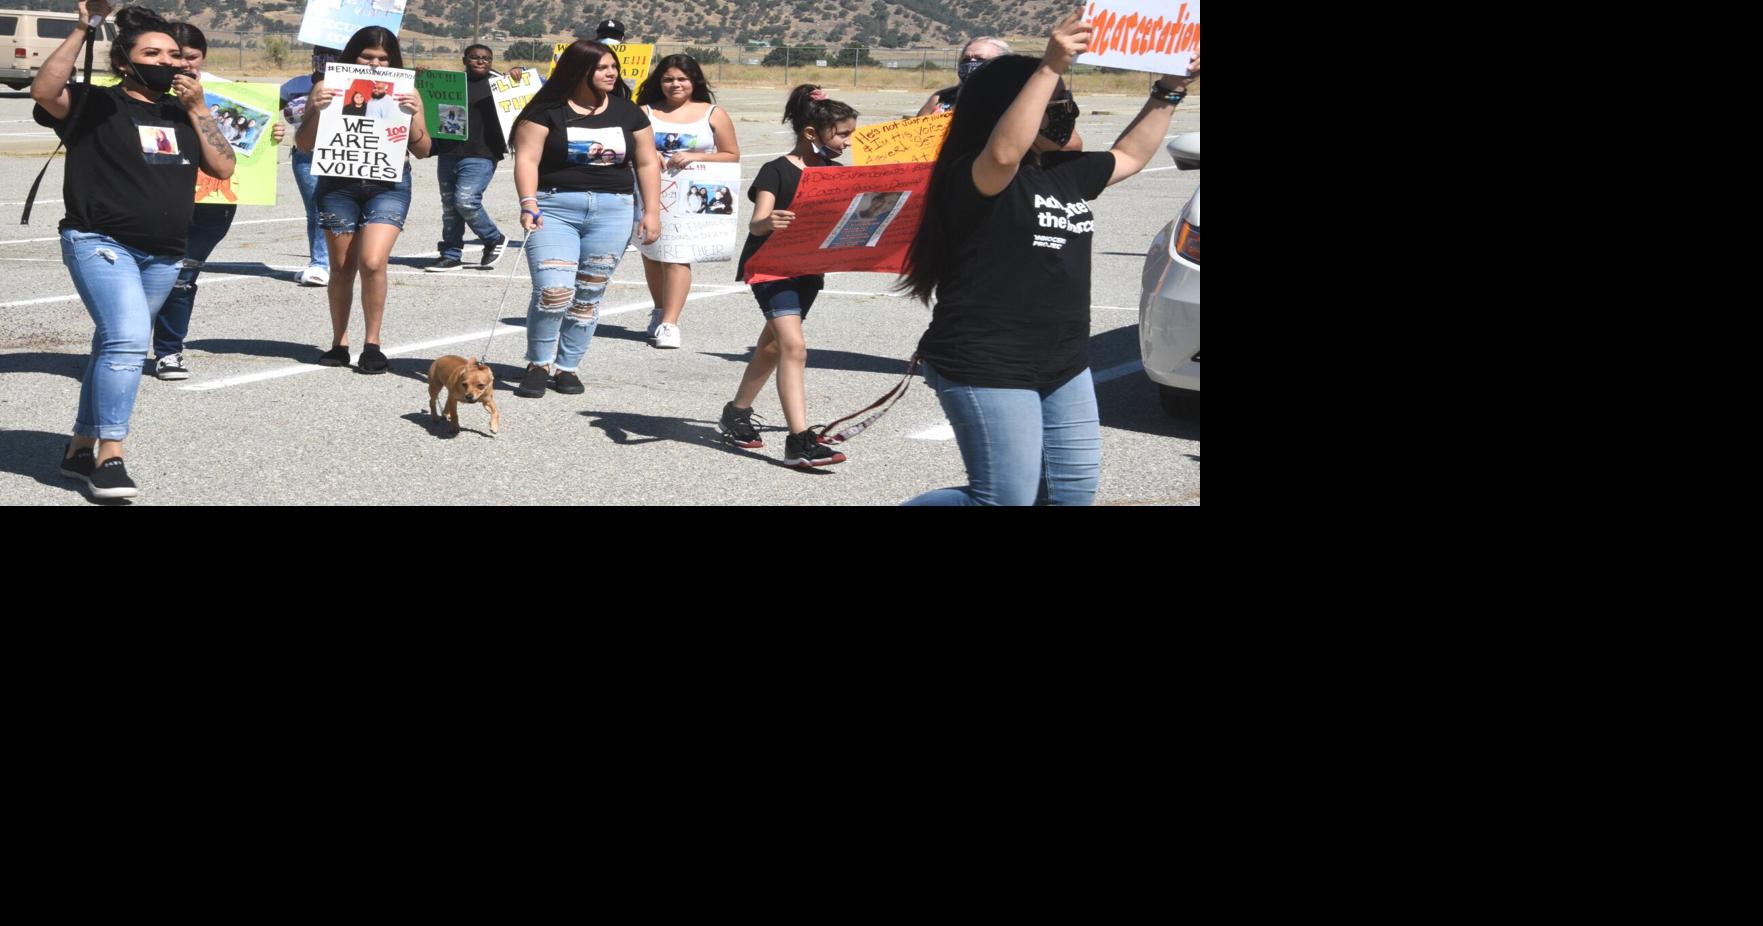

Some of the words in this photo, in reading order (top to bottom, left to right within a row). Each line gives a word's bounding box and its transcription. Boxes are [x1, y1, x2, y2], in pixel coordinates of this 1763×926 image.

[428, 89, 465, 101] VOICE
[343, 118, 374, 134] WE
[329, 133, 379, 150] ARE
[317, 148, 392, 167] THEIR
[317, 162, 397, 180] VOICES
[1037, 211, 1068, 229] the
